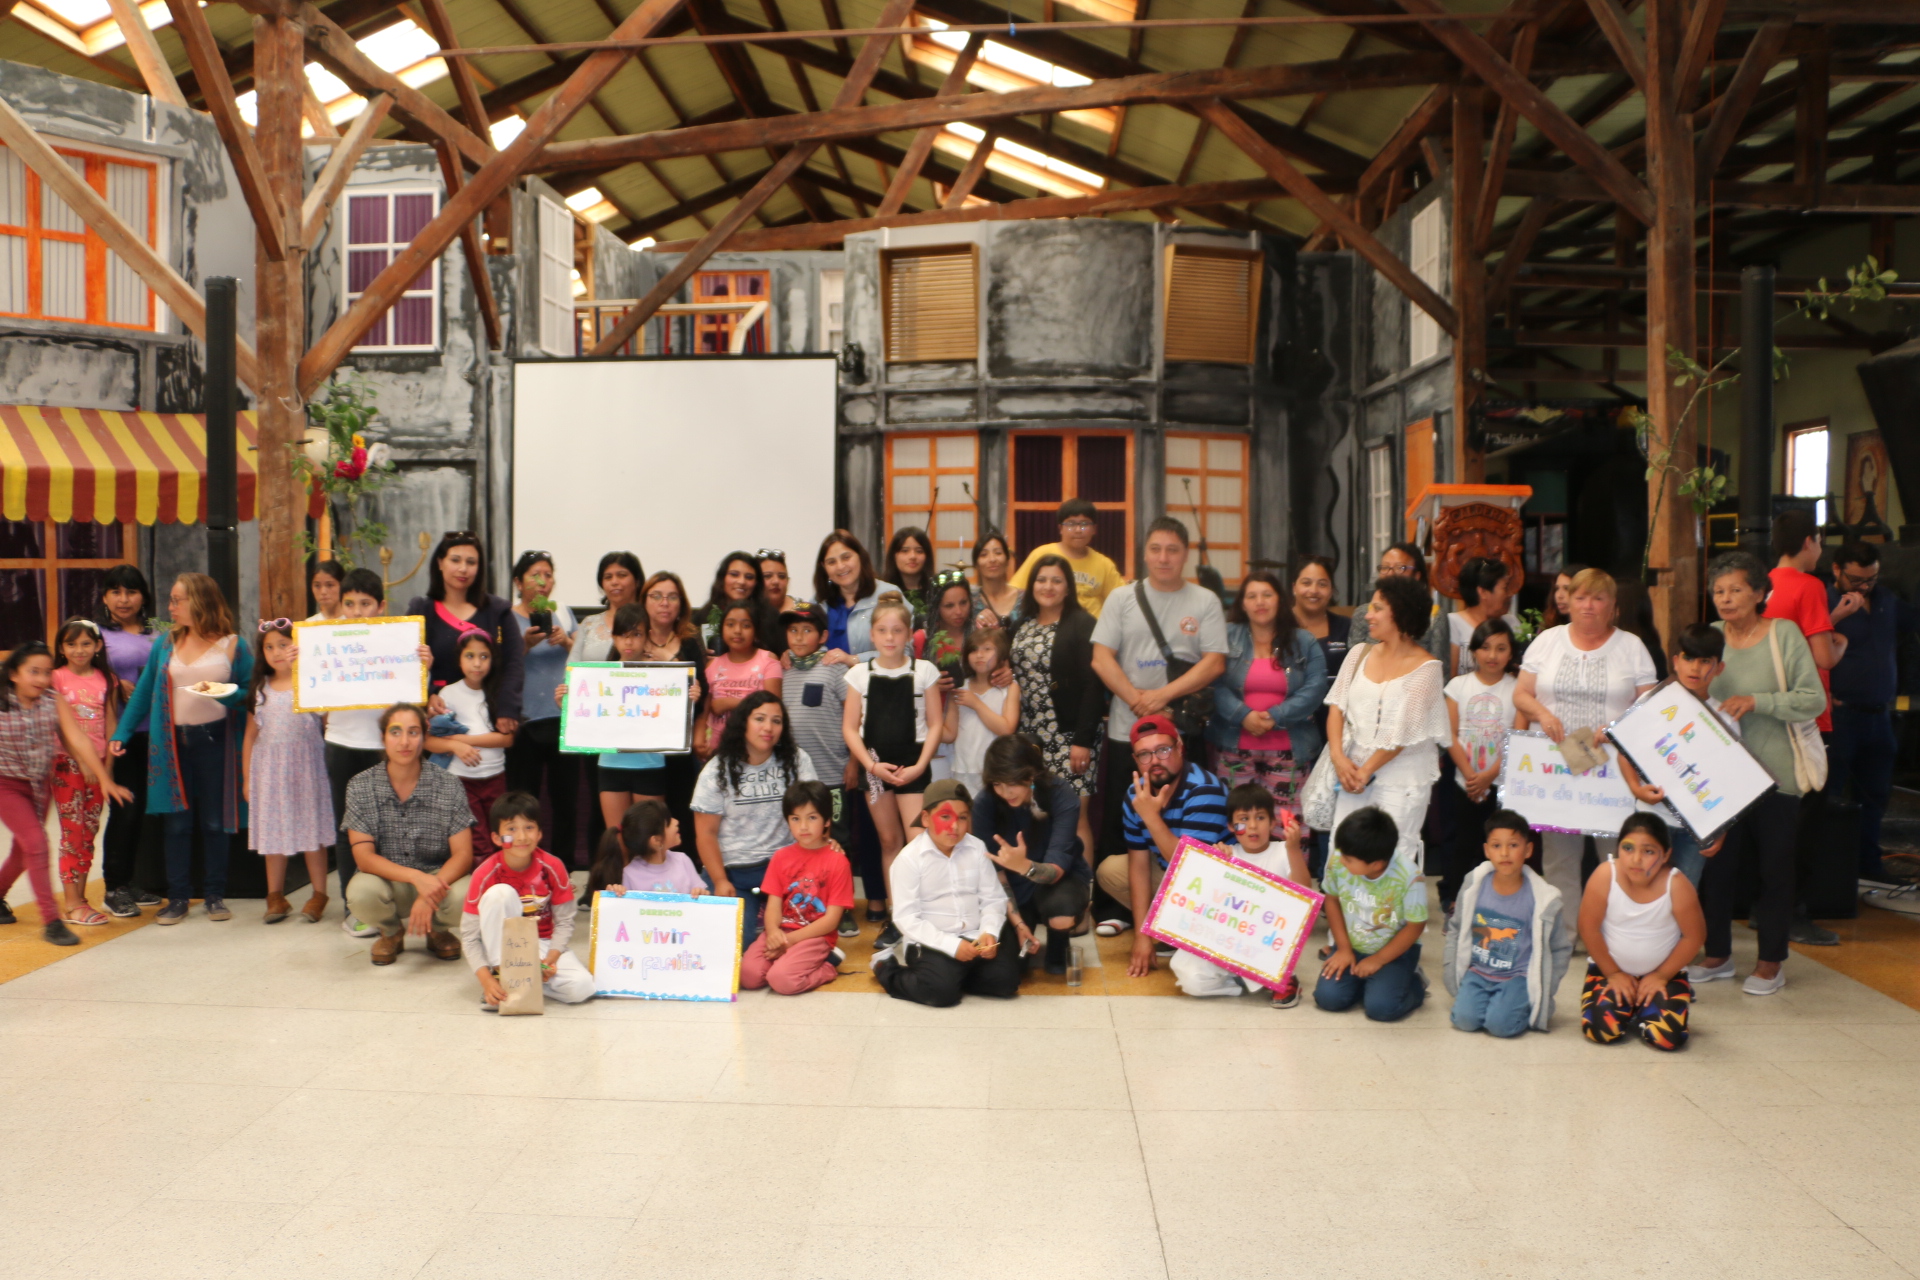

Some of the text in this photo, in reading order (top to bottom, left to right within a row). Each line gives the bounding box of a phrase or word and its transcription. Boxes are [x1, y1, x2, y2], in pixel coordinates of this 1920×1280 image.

[313, 644, 321, 656] A
[326, 643, 337, 655] la
[321, 660, 328, 669] a
[334, 658, 344, 668] la
[309, 676, 316, 688] y
[321, 670, 332, 682] al
[577, 679, 682, 704] A la protección
[575, 703, 591, 717] de
[597, 703, 610, 717] la
[1661, 705, 1696, 743] A la
[1698, 711, 1731, 746] DERECHO
[1518, 754, 1533, 773] A
[740, 782, 780, 798] CLUB
[1553, 783, 1573, 800] de
[1223, 871, 1266, 893] DERECHO
[639, 908, 683, 917] DERECHO
[1187, 876, 1203, 895] A
[1262, 910, 1287, 930] en
[1170, 892, 1285, 951] condiciones de
[615, 921, 691, 944] A vivir
[608, 950, 706, 980] en familia
[1489, 957, 1513, 970] UP!
